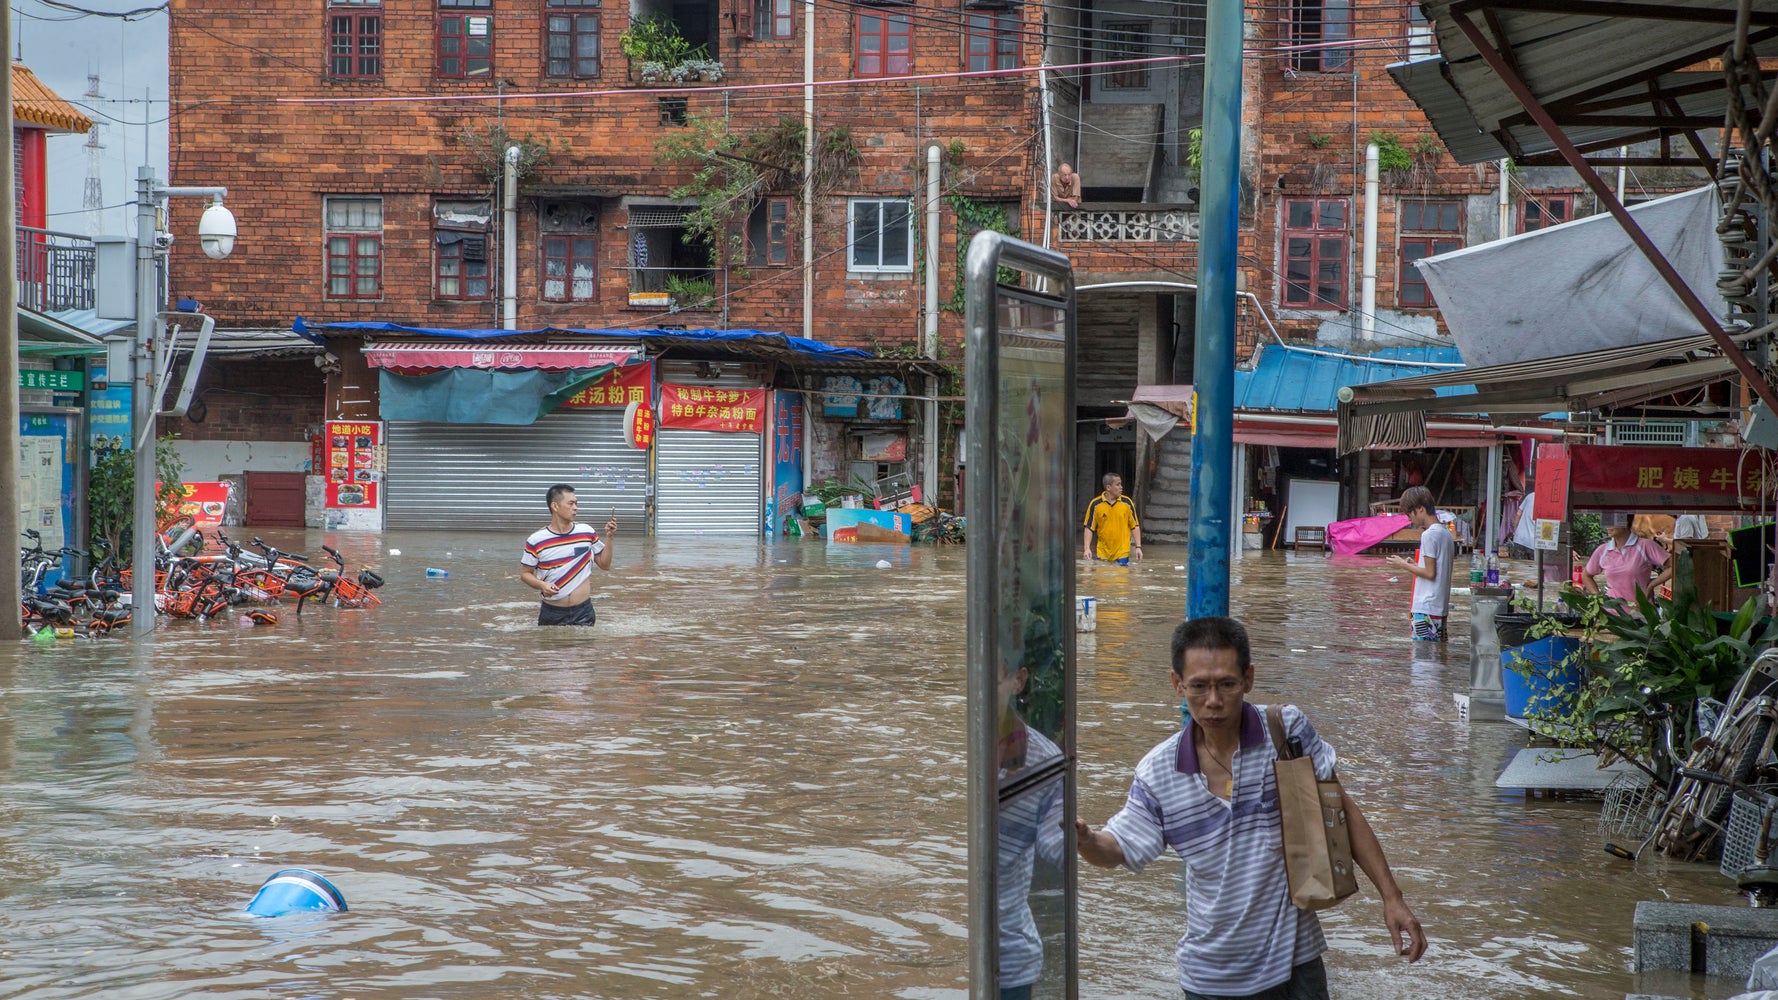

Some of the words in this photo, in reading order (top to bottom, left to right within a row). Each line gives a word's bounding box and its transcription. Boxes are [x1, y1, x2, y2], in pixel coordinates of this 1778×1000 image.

[677, 387, 751, 404] 秘制牛杂萝卜
[671, 403, 757, 421] 特色牛杂汤粉面
[331, 424, 371, 435] 地道小吃
